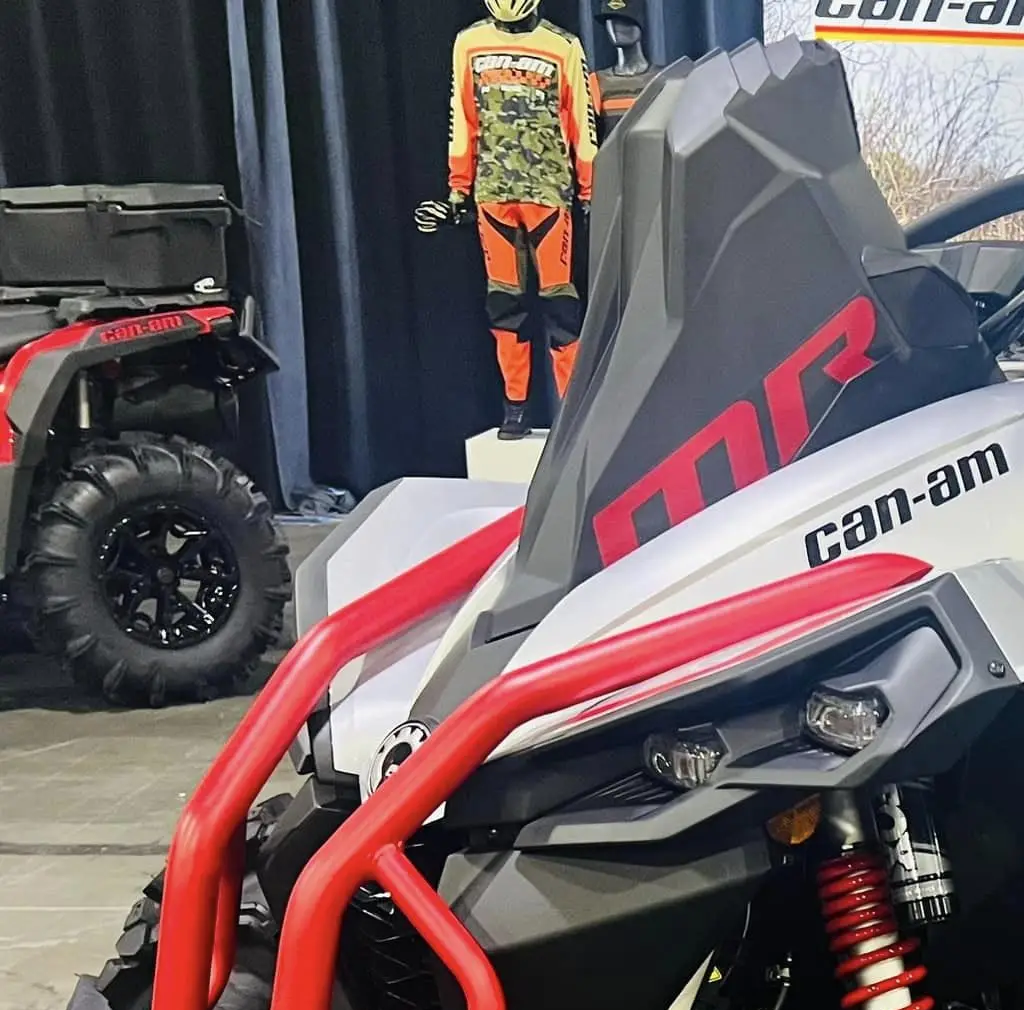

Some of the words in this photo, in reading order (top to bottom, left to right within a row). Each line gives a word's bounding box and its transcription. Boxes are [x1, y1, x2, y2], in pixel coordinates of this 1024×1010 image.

[473, 55, 555, 77] can-am
[99, 314, 184, 344] can-am
[804, 442, 1010, 569] can-am
